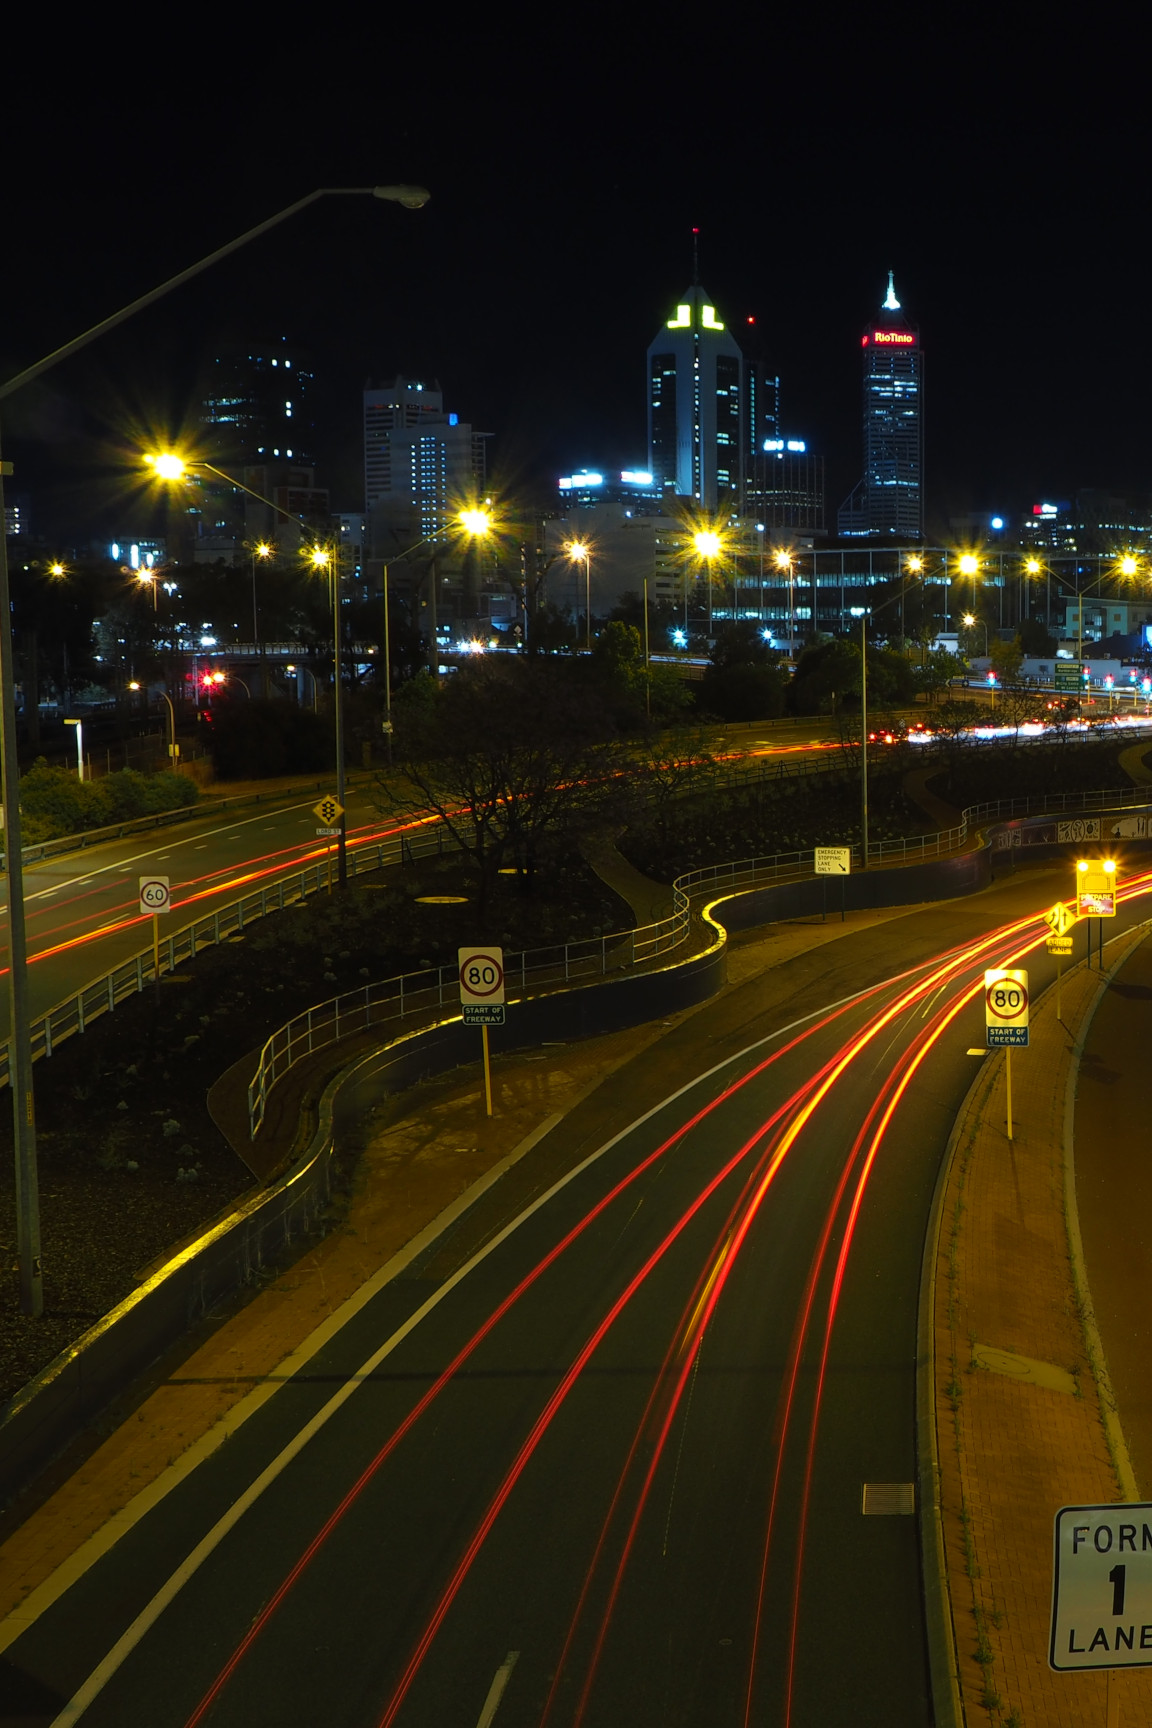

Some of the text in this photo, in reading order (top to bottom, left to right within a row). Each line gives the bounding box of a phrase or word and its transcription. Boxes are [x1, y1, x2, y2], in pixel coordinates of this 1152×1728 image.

[874, 331, 913, 343] RioTinto
[146, 889, 163, 900] 60
[469, 967, 495, 985] 80
[995, 990, 1020, 1007] 80
[1109, 1564, 1126, 1616] 1
